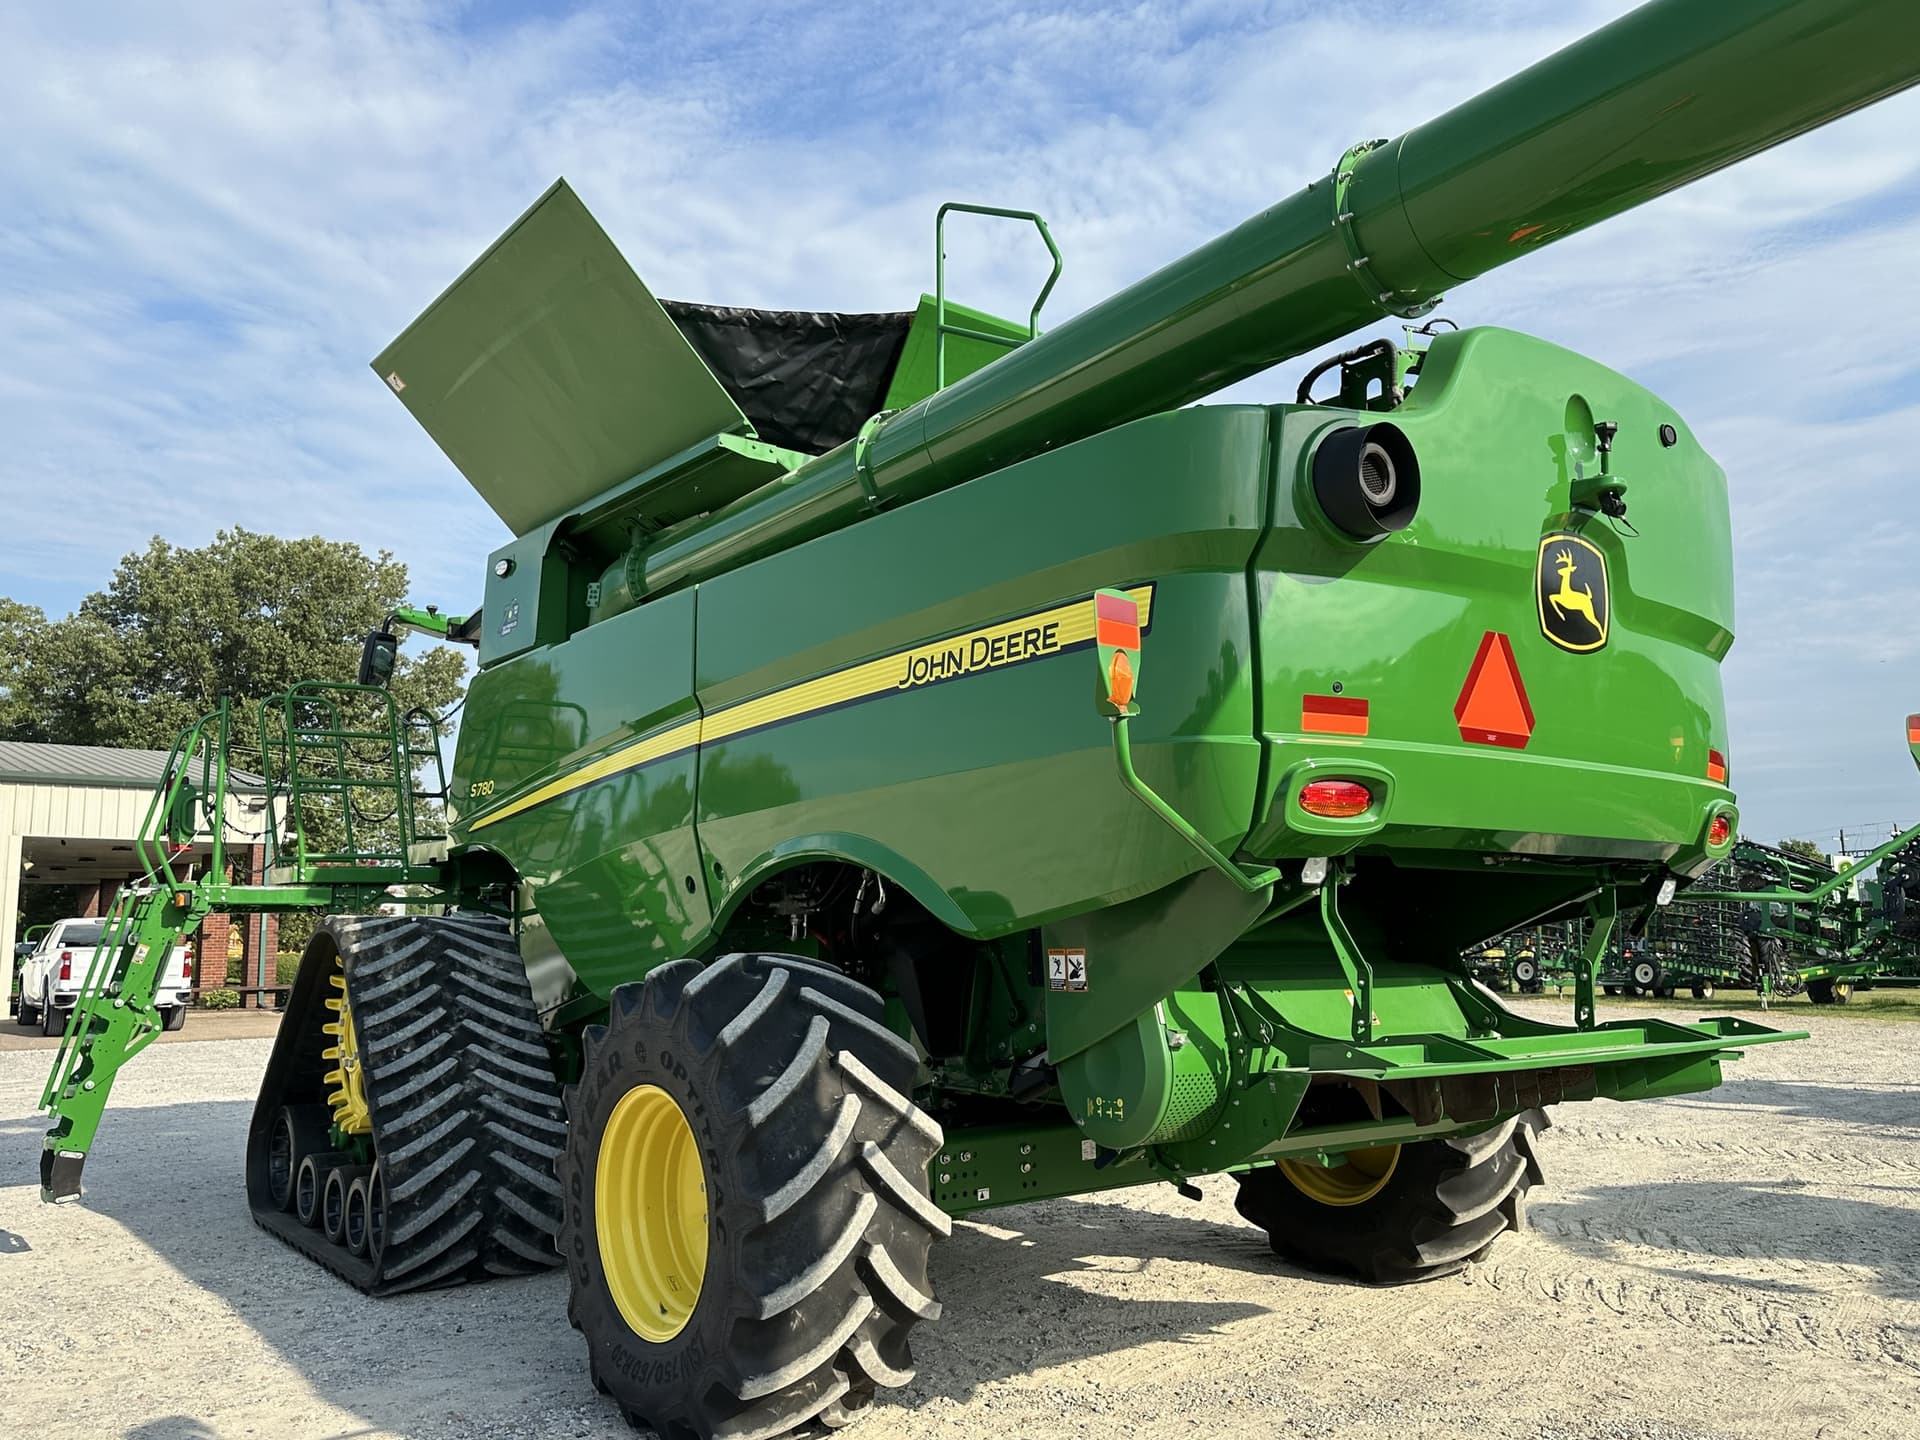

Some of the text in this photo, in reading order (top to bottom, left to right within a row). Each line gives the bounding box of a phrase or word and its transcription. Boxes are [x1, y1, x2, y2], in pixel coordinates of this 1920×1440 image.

[898, 621, 1060, 686] JOHN DEERE
[470, 780, 495, 797] S780
[659, 1050, 727, 1246] OPTITRAC
